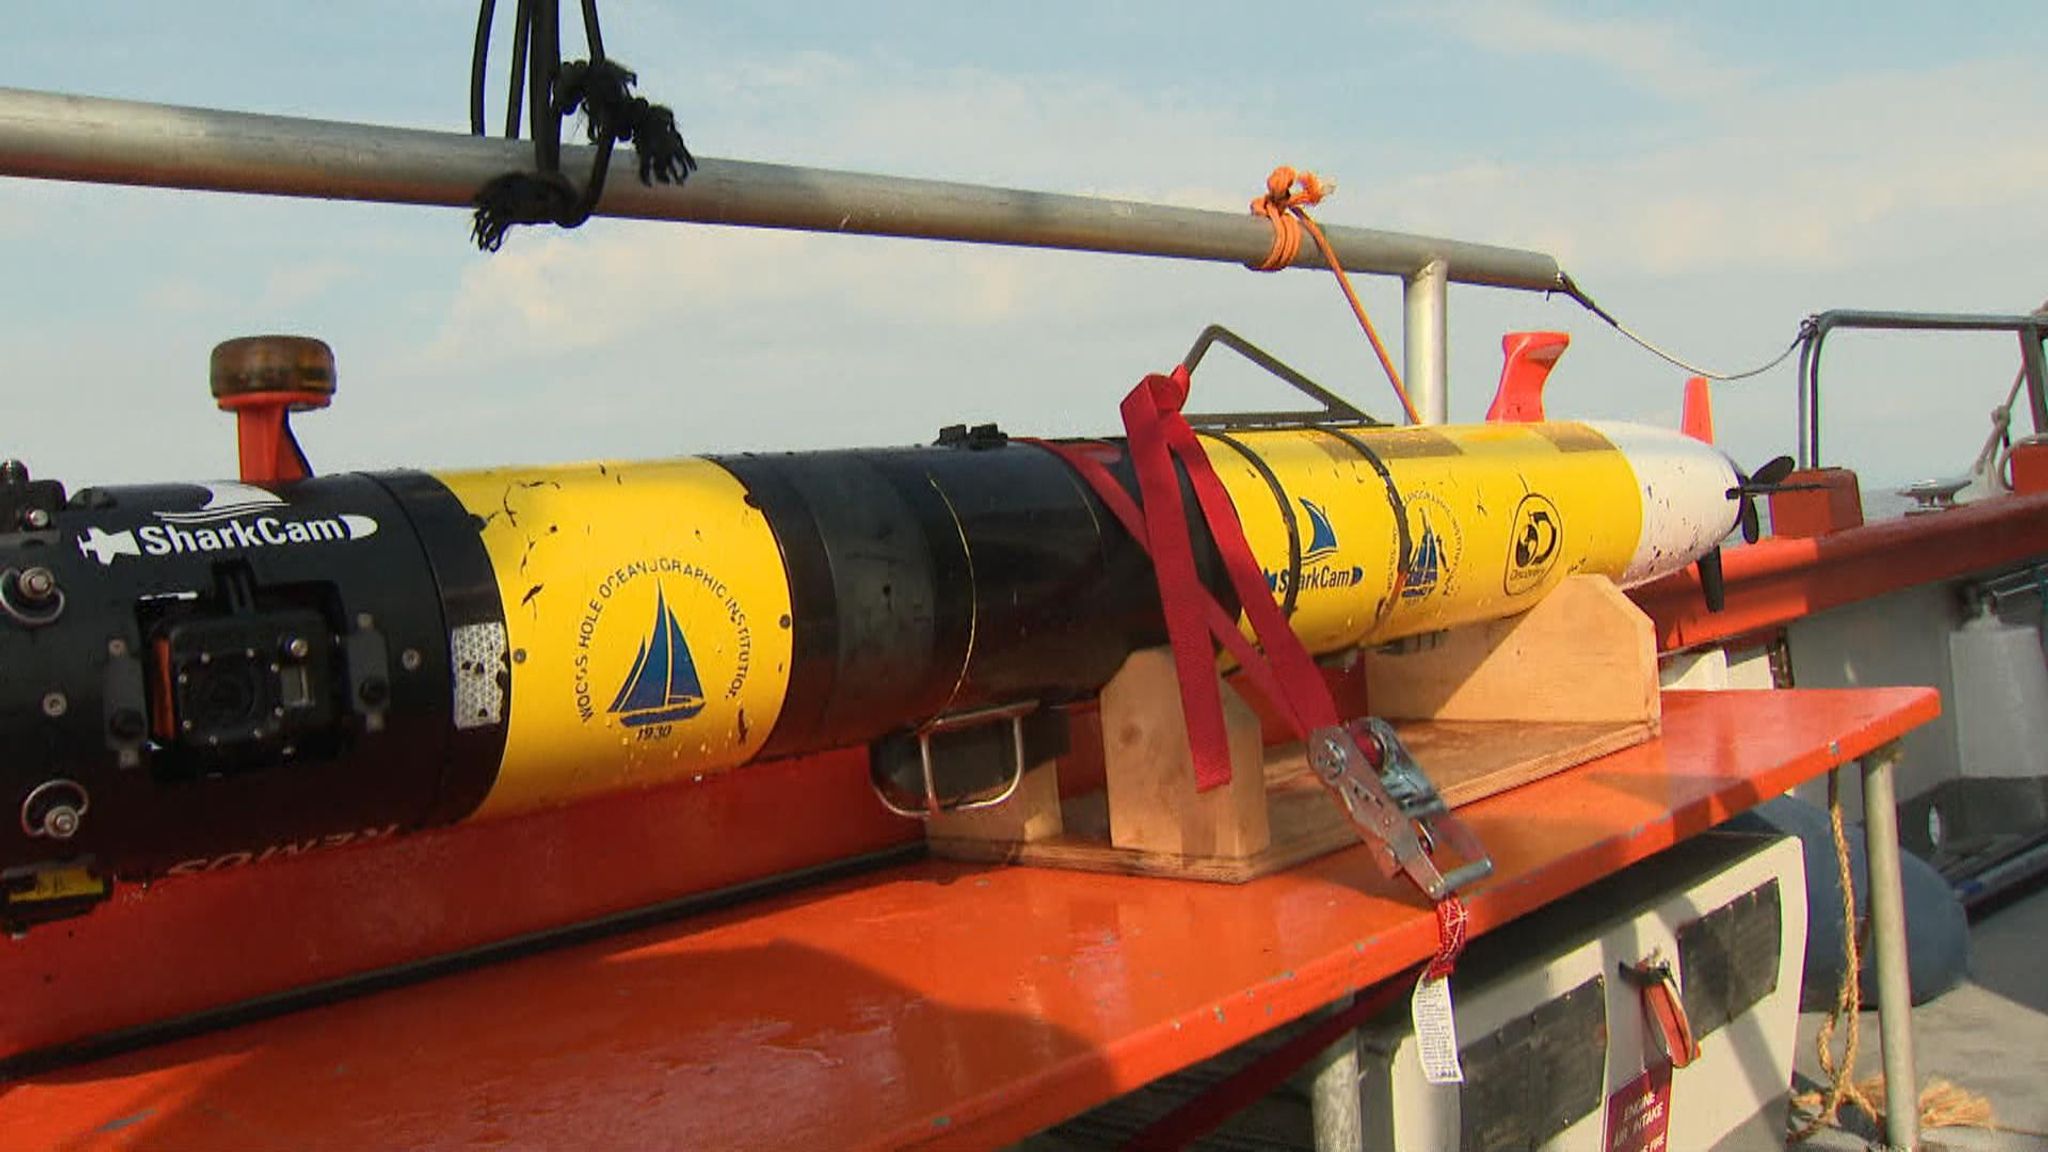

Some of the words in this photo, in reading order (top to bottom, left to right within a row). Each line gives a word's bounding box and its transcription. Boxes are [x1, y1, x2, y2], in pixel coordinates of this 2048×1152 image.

[138, 517, 345, 556] SharkCam
[1278, 565, 1350, 593] SarkCam
[579, 598, 603, 650] HOLE
[637, 724, 672, 742] 1930
